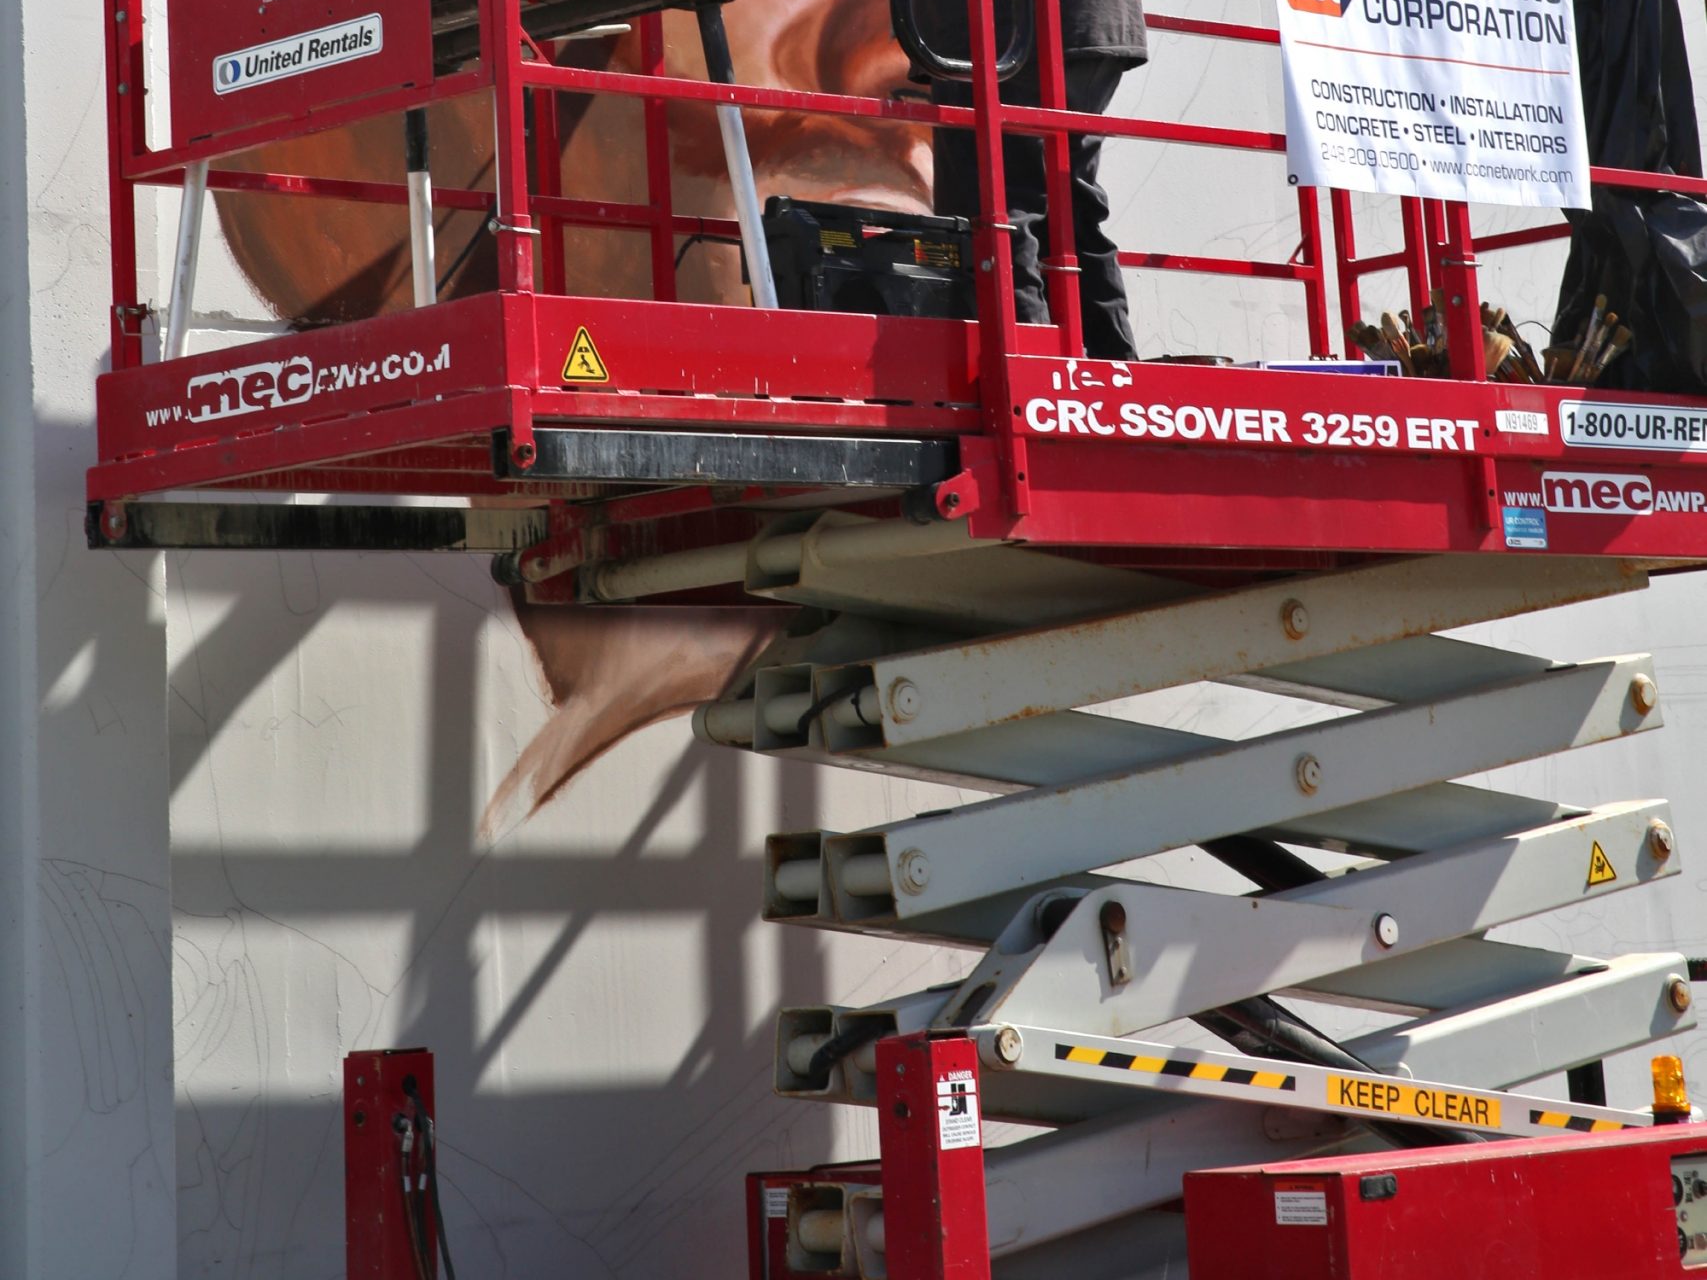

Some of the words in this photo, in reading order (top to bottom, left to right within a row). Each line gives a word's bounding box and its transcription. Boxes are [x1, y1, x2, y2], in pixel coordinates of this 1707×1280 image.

[245, 41, 303, 78] United
[307, 25, 373, 62] Rentals
[1311, 79, 1436, 112] CONSTRUCTION
[1450, 95, 1563, 124] INSTALLATION
[1315, 110, 1400, 140] CONCRETE
[1413, 123, 1466, 146] STEEL
[1478, 129, 1568, 154] INTERIORS
[1429, 159, 1574, 183] www.cccnetwork.com
[1025, 397, 1293, 443] CROSSOVER
[1301, 411, 1400, 448] 3259
[1405, 416, 1480, 451] ERT
[947, 1070, 973, 1082] DANGER
[1339, 1078, 1400, 1112] KEEP
[1414, 1089, 1490, 1126] CLEAR
